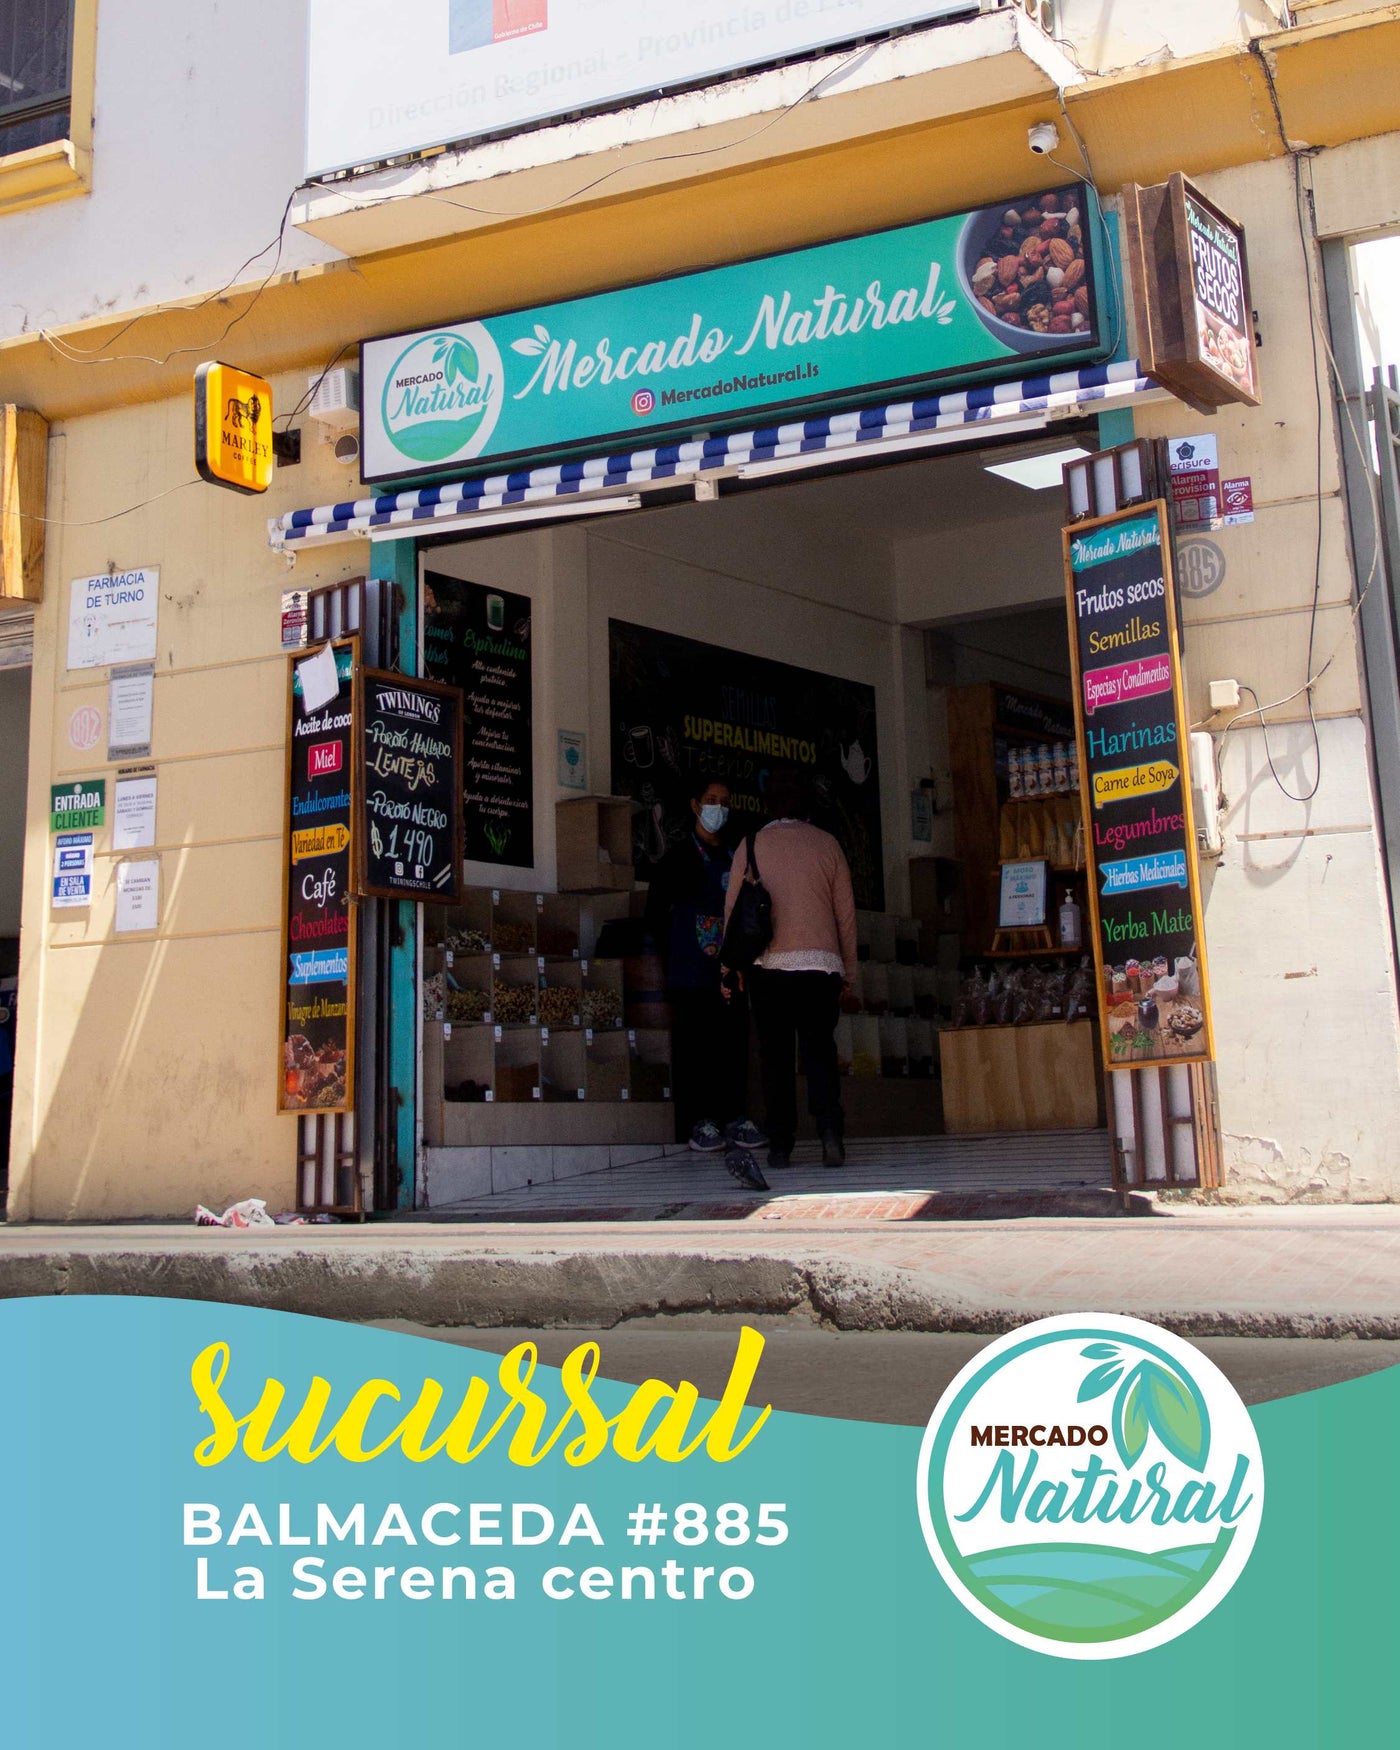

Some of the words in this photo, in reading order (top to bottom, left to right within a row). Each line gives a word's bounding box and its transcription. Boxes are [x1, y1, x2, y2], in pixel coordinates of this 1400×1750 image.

[368, 84, 487, 129] Dirección
[495, 48, 608, 98] Regional
[638, 7, 766, 60] Provincia
[1190, 230, 1240, 297] FRUTOS
[1197, 265, 1239, 326] SECOS
[513, 313, 733, 400] Mercado
[735, 262, 945, 355] Natural
[396, 371, 444, 388] MERCADO
[661, 362, 820, 407] MercadoNatural.ls
[390, 373, 494, 420] Natural
[221, 430, 269, 458] MARLEY
[1171, 458, 1212, 471] erisure
[1171, 482, 1216, 497] rovision
[1223, 480, 1250, 490] Alarma
[1074, 538, 1114, 565] Mercado
[1115, 524, 1157, 553] Natural
[87, 572, 145, 592] FARMACIA
[1076, 584, 1124, 617] Frutos
[1126, 577, 1165, 604] secos
[86, 595, 101, 609] DE
[105, 588, 144, 606] TURNO
[1089, 616, 1160, 654] Semillas
[1087, 676, 1116, 706] Especias
[1116, 680, 1122, 700] y
[1122, 661, 1170, 691] Condimentos
[376, 691, 441, 723] TWININGS
[295, 717, 320, 737] Aceite
[322, 710, 333, 731] de
[333, 712, 353, 729] coco
[683, 714, 817, 765] SUPERALIMENTOS
[1087, 721, 1177, 759] Harinas
[314, 743, 336, 771] Miel
[1095, 776, 1129, 793] Carne
[1132, 768, 1146, 786] de
[1149, 766, 1175, 787] Soya
[55, 791, 101, 812] ENTRADA
[292, 789, 352, 816] Endulcorantes
[411, 801, 447, 830] NEGRO
[55, 809, 100, 830] CLIENTE
[1093, 807, 1185, 851] Legumbres
[293, 826, 325, 854] Variedad
[326, 834, 334, 849] en
[336, 828, 345, 848] Té
[60, 878, 69, 887] EN
[69, 876, 84, 886] SALA
[1108, 863, 1139, 887] Hierbas
[1140, 854, 1185, 882] Medicinales
[67, 884, 86, 896] VENTA
[302, 867, 336, 908] Café
[290, 907, 349, 942] Chocolates
[1102, 910, 1149, 942] Yerba
[1150, 908, 1193, 936] Mate
[295, 950, 347, 985] Suplementos
[287, 1001, 311, 1027] Vinagre
[311, 996, 320, 1018] de
